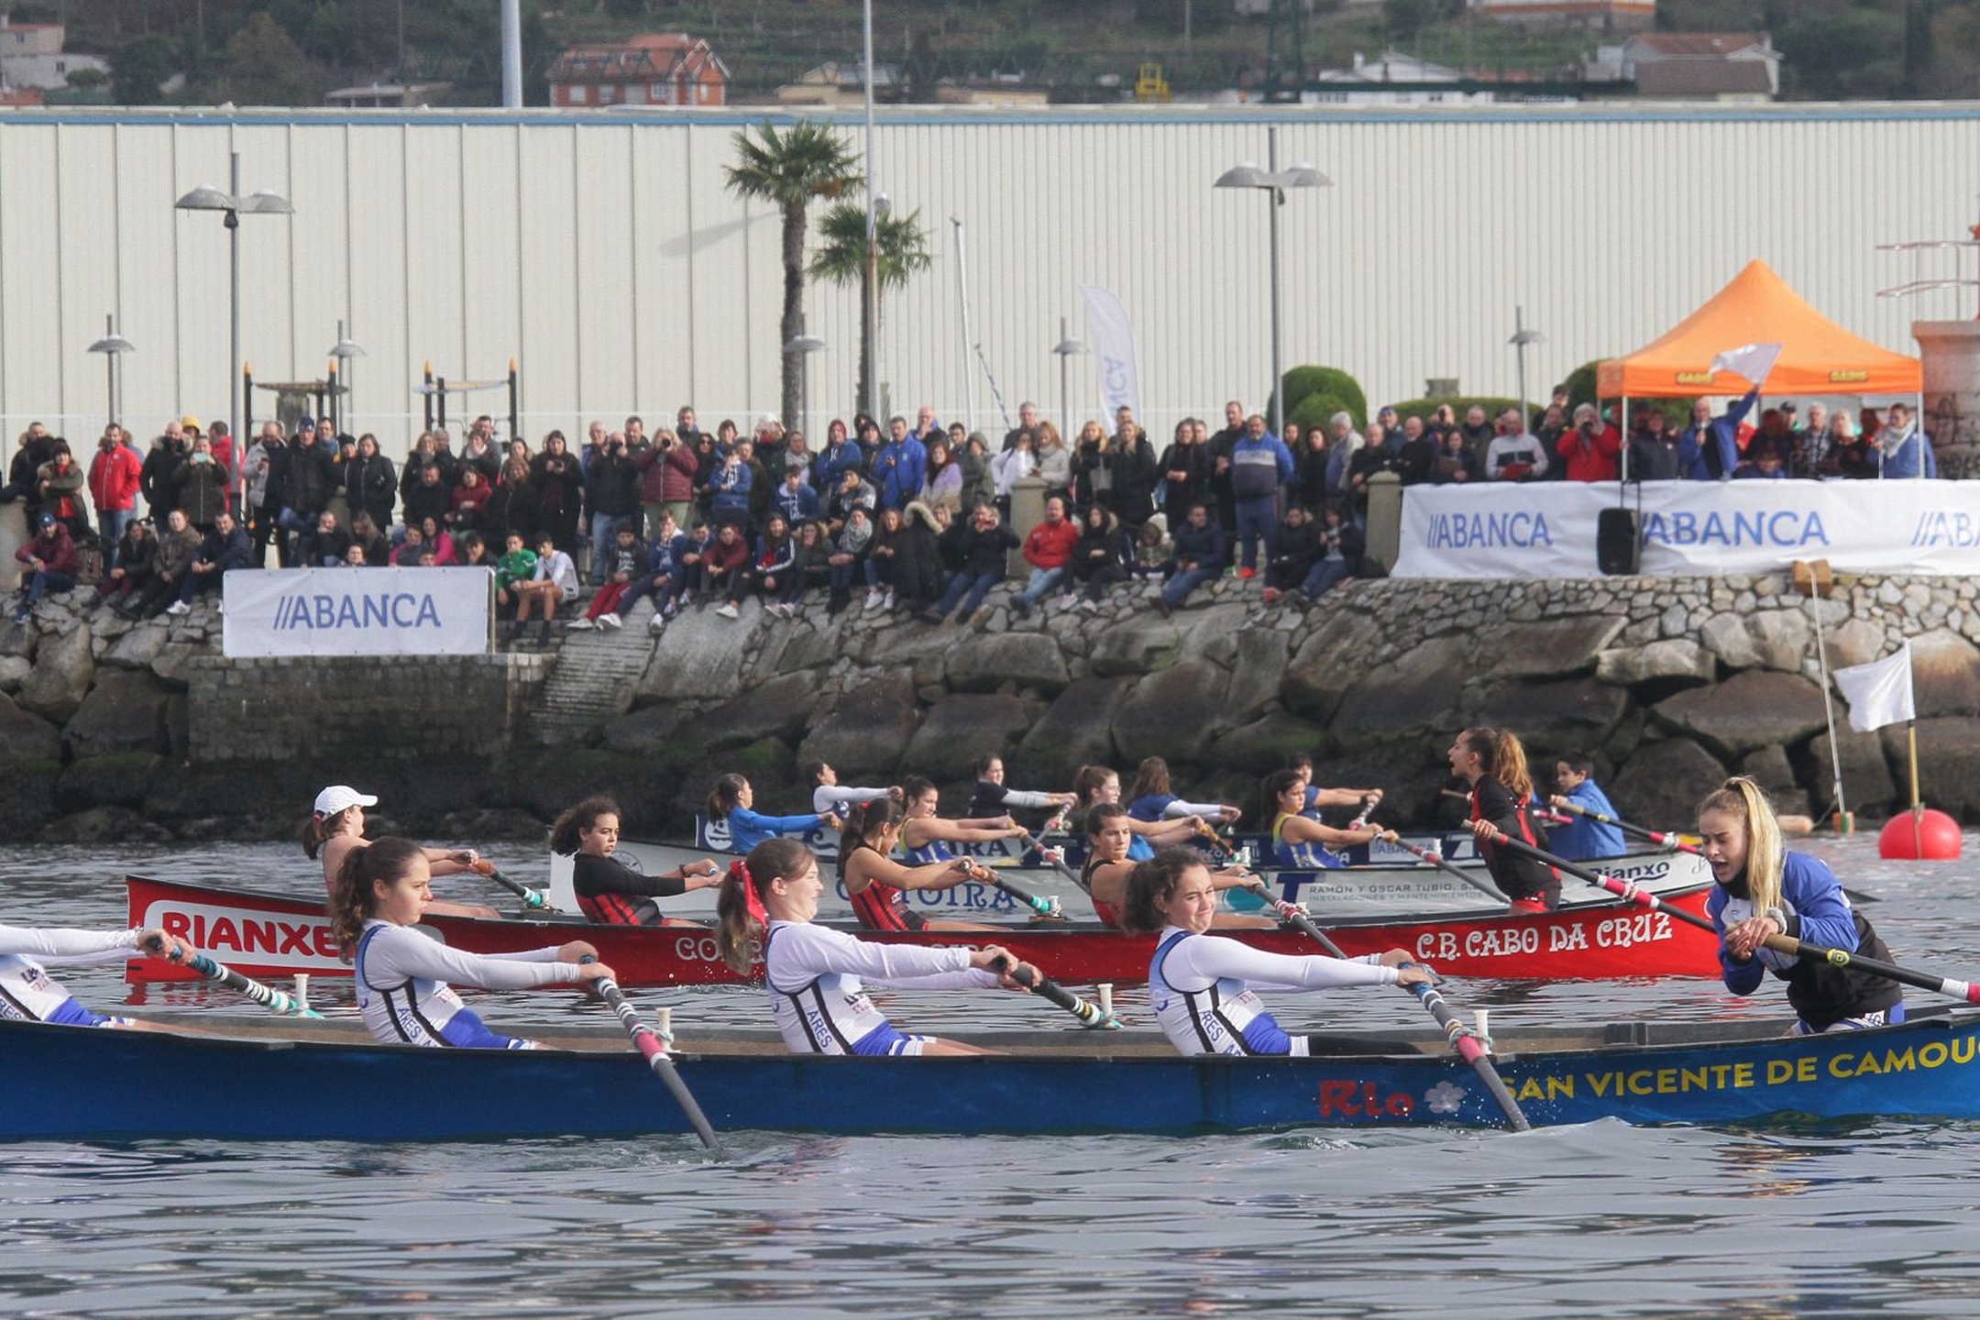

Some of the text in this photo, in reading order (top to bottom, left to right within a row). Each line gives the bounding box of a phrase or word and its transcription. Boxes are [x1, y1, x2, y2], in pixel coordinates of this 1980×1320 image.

[162, 911, 339, 957] RIANXE
[1465, 927, 1540, 957] CABO
[1549, 922, 1589, 952] DA
[1596, 911, 1673, 949] CRUZ
[807, 1010, 833, 1049] ARES
[1585, 1062, 1755, 1098] VICENTE
[1767, 1056, 1818, 1085] DE
[1828, 1036, 1980, 1079] CAMOU
